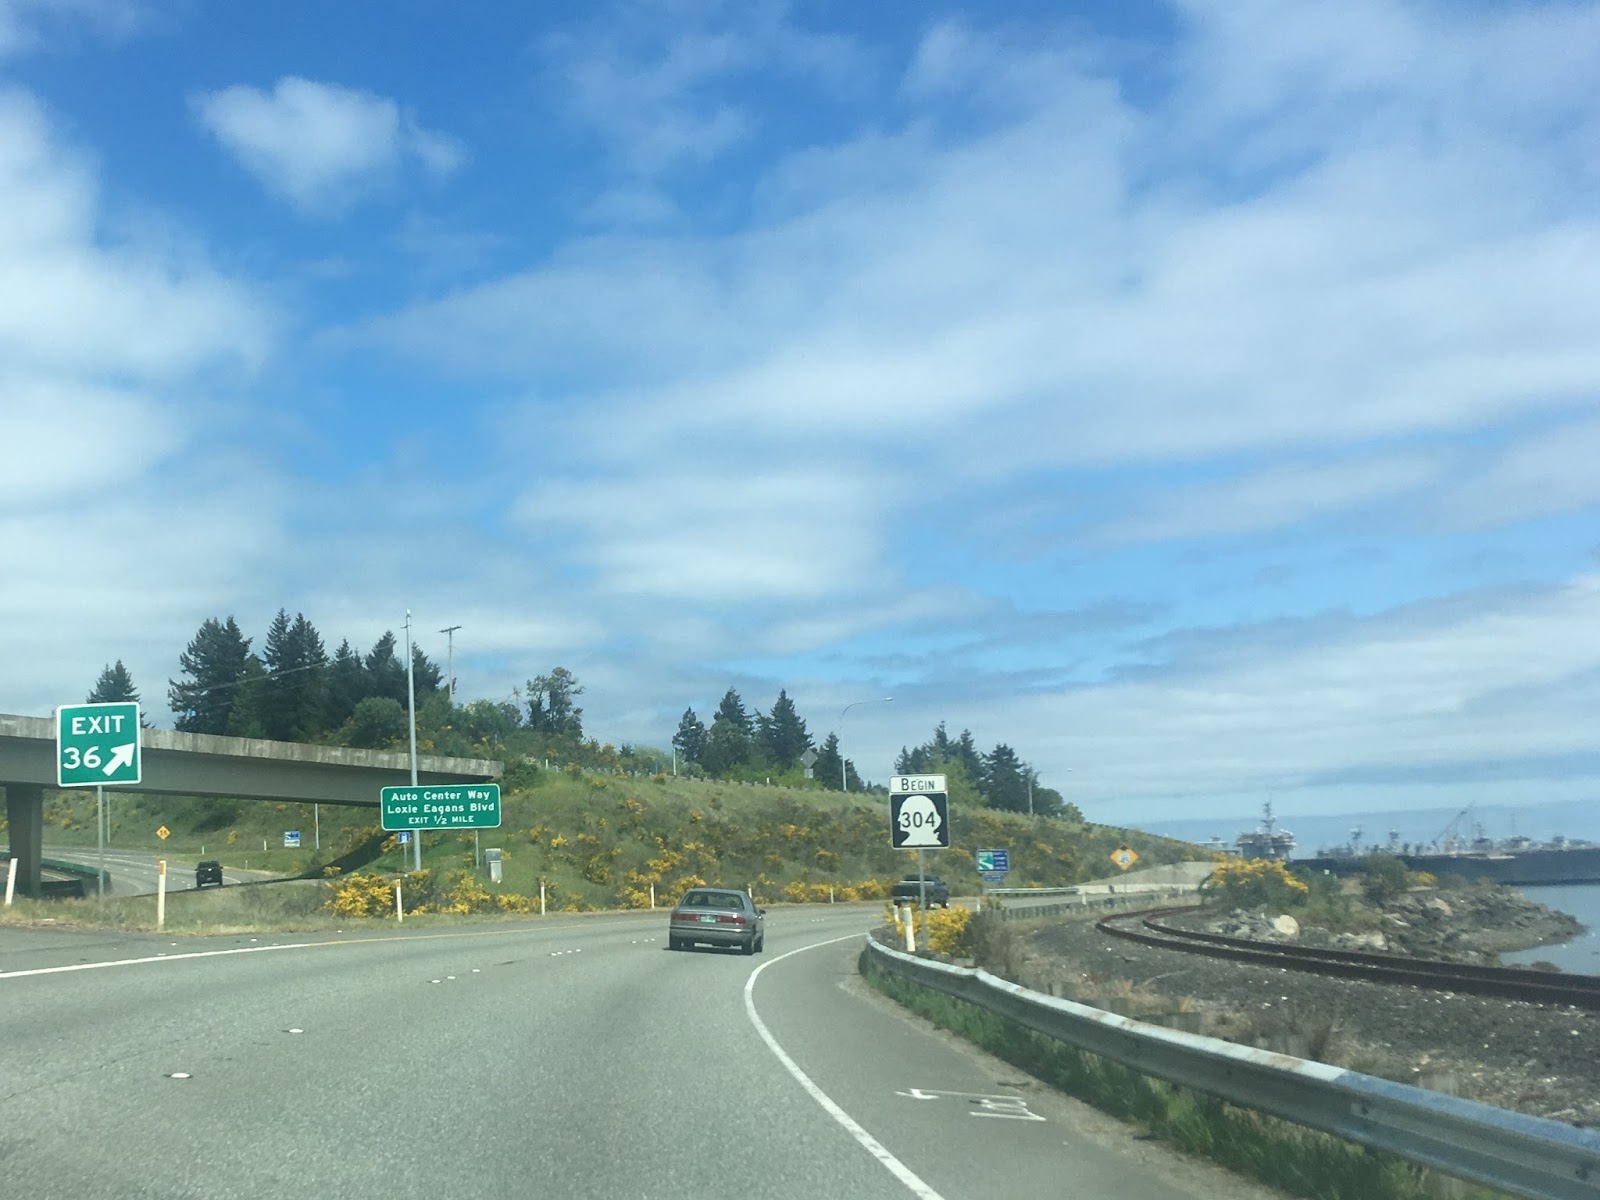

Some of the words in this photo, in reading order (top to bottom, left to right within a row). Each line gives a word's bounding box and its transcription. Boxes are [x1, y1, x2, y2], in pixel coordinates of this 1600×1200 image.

[72, 715, 125, 735] EXIT
[62, 746, 102, 769] 36
[901, 777, 935, 791] BEGIN
[391, 792, 418, 801] Auto
[423, 791, 461, 800] Center
[467, 790, 490, 800] Way
[387, 804, 418, 814] Loxie
[423, 803, 465, 815] Eagans
[470, 802, 495, 812] Blvd
[408, 817, 429, 825] EXIT
[451, 815, 475, 823] MILE
[901, 812, 936, 828] 304
